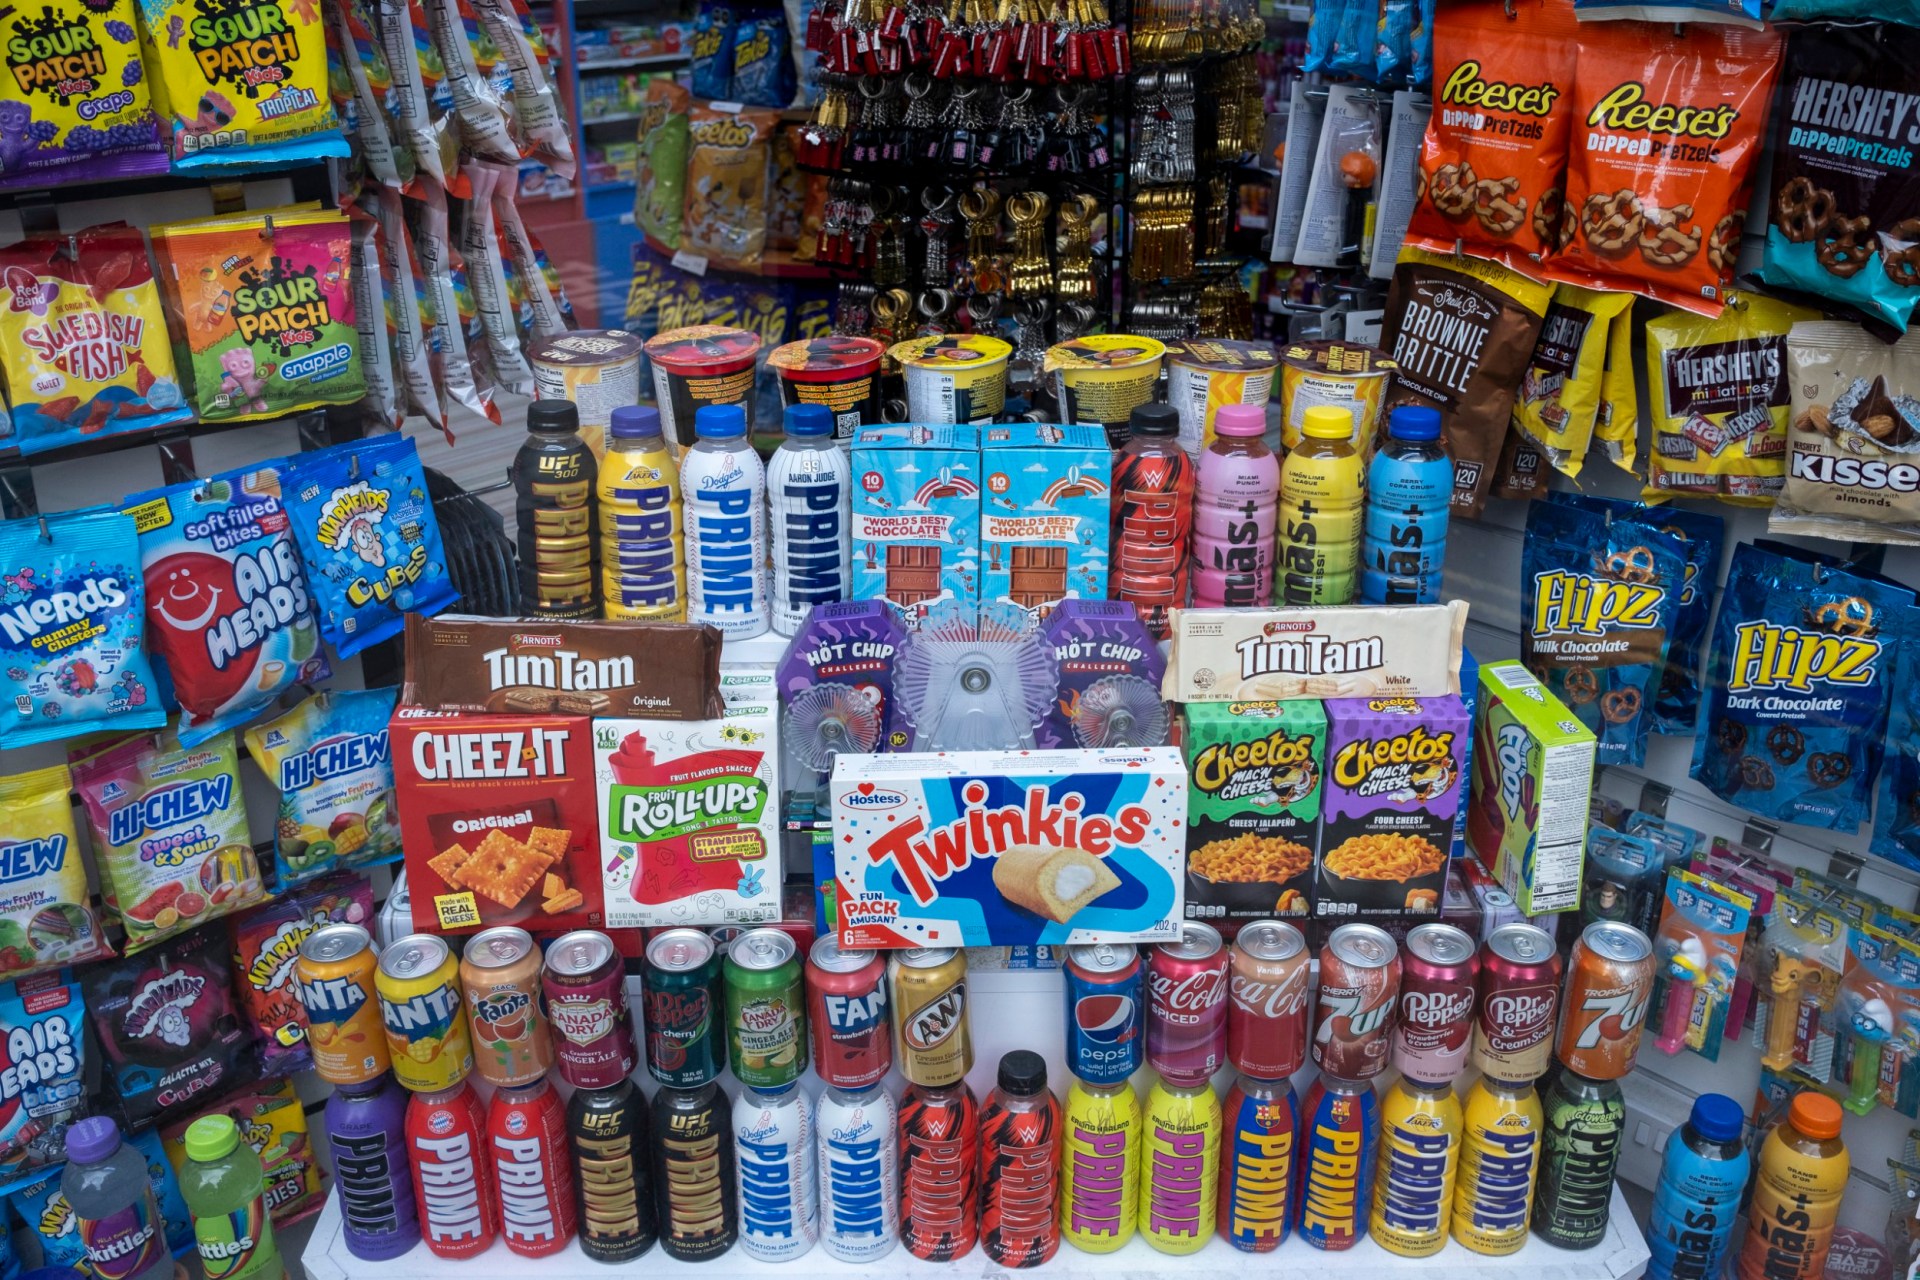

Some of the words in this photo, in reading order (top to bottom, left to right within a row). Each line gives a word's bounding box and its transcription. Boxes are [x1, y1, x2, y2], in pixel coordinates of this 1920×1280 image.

[193, 5, 286, 47] SOUR
[195, 33, 299, 79] PATCH
[735, 31, 769, 72] Takis
[244, 67, 284, 86] Kids
[78, 90, 135, 120] Grape
[258, 88, 319, 121] TROPICAL
[1588, 84, 1738, 138] Reese's
[16, 285, 39, 296] Red
[16, 293, 46, 307] Band
[65, 301, 92, 312] ORIGINAL
[22, 311, 143, 361] SWEDISH
[1402, 301, 1488, 360] BROWNIE
[69, 342, 127, 381] FISH
[284, 347, 349, 378] snapple
[1394, 334, 1477, 393] BRITTLE
[1678, 349, 1781, 388] HERSHEY'S
[36, 378, 61, 392] SWEET
[1304, 379, 1333, 387] Nutrition
[1335, 382, 1354, 391] Facts
[1398, 377, 1433, 398] CHOCOLATE
[1434, 391, 1448, 402] CHIP
[1692, 383, 1770, 400] miniatures
[1794, 441, 1821, 452] HERSHEY'S
[540, 453, 581, 472] UFC
[802, 460, 821, 473] 99
[554, 469, 579, 479] 300
[622, 468, 661, 481] LAKERS
[701, 466, 744, 490] Dodgers
[788, 473, 812, 483] AARON
[814, 471, 835, 482] JUDGE
[864, 475, 880, 486] 10
[1456, 469, 1476, 482] 120
[301, 484, 321, 501] NEW
[1836, 493, 1891, 507] almonds
[1846, 488, 1880, 498] chocolate
[136, 510, 157, 523] NOW
[187, 511, 226, 540] soft
[227, 500, 279, 529] filled
[317, 490, 389, 546] WARHEADS
[920, 517, 947, 525] BEST
[213, 523, 262, 551] bites
[531, 481, 592, 608] PRIME
[614, 485, 678, 608] PRIME
[697, 489, 753, 614] PRIME
[348, 546, 428, 605] CUBES
[0, 578, 126, 644] Nerds
[824, 605, 870, 617] EDITION
[1534, 570, 1664, 636] Flipz
[698, 619, 738, 627] HYDRATION
[739, 618, 759, 626] DRINK
[31, 618, 90, 648] Gummy
[48, 624, 106, 652] Clusters
[522, 635, 562, 646] ARNOTT'S
[851, 642, 895, 660] CHIP
[1534, 640, 1559, 653] Milk
[1561, 639, 1629, 653] Chocolate
[821, 662, 882, 673] CHALLENGE
[1386, 675, 1411, 685] White
[16, 696, 31, 706] 100
[107, 698, 129, 707] very
[633, 695, 672, 708] Original
[106, 704, 133, 715] berry
[892, 734, 906, 744] 16+
[282, 730, 389, 791] HI-CHEW
[412, 728, 569, 780] CHEEZ-IT
[1195, 731, 1313, 787] Cheetos
[670, 773, 690, 782] FRUIT
[691, 767, 724, 779] FLAVORED
[724, 765, 753, 773] SNACKS
[1500, 725, 1529, 822] FOOT
[1221, 780, 1272, 799] CHEESE
[307, 802, 333, 815] Intensely
[333, 793, 364, 807] Chewy
[365, 786, 383, 796] Candy
[849, 794, 901, 806] Hostess
[623, 783, 759, 836] ROLL-UPS
[1259, 818, 1296, 826] JALAPEÑO
[1374, 816, 1390, 824] FOUR
[1393, 816, 1423, 824] CHEESY
[695, 834, 755, 847] STRAWBERRY
[867, 783, 1151, 904] Twinkies
[697, 846, 727, 855] BLAST
[440, 898, 454, 906] made
[860, 893, 883, 901] FUN
[441, 904, 474, 916] REAL
[845, 902, 898, 916] PACK
[444, 913, 476, 925] CHEESE
[849, 916, 897, 925] AMUSANT
[1154, 920, 1170, 931] 202
[844, 930, 854, 945] 6
[1257, 966, 1285, 975] Vanilla
[492, 984, 517, 992] PEACH
[1322, 985, 1362, 996] CHERRY
[1584, 982, 1638, 996] TROPICAL
[123, 978, 205, 1034] WARHEADS
[478, 993, 529, 1021] Fanta
[1405, 993, 1471, 1026] Pepper
[1430, 993, 1456, 1010] Dr
[1693, 993, 1709, 1024] PEZ
[552, 1009, 611, 1025] CANADA
[921, 996, 957, 1045] A&W
[1152, 1005, 1199, 1024] SPICED
[663, 1030, 696, 1039] cherry
[832, 1027, 874, 1041] strawberry
[1408, 1030, 1454, 1041] Strawberries
[1493, 1034, 1531, 1049] Cream
[1532, 1025, 1552, 1041] Soda
[560, 1053, 596, 1064] GINGER
[598, 1050, 617, 1063] ALE
[1081, 1047, 1130, 1062] pepsi
[159, 1063, 197, 1087] GALACTIC
[199, 1058, 215, 1072] MIX
[1078, 1069, 1104, 1077] cherry
[157, 1063, 223, 1107] CUBES
[31, 1103, 58, 1115] ORIGINAL
[59, 1099, 78, 1109] FRUIT
[1071, 1116, 1096, 1130] ERLING
[1554, 1129, 1619, 1227] PRIME
[1788, 1166, 1818, 1179] ORANGE
[1792, 1174, 1810, 1183] D'OR
[330, 1131, 398, 1236] PRIME
[416, 1132, 482, 1242] PRIME
[910, 1134, 962, 1238] PRIME
[1072, 1127, 1125, 1236] PRIME
[1234, 1130, 1291, 1239] PRIME
